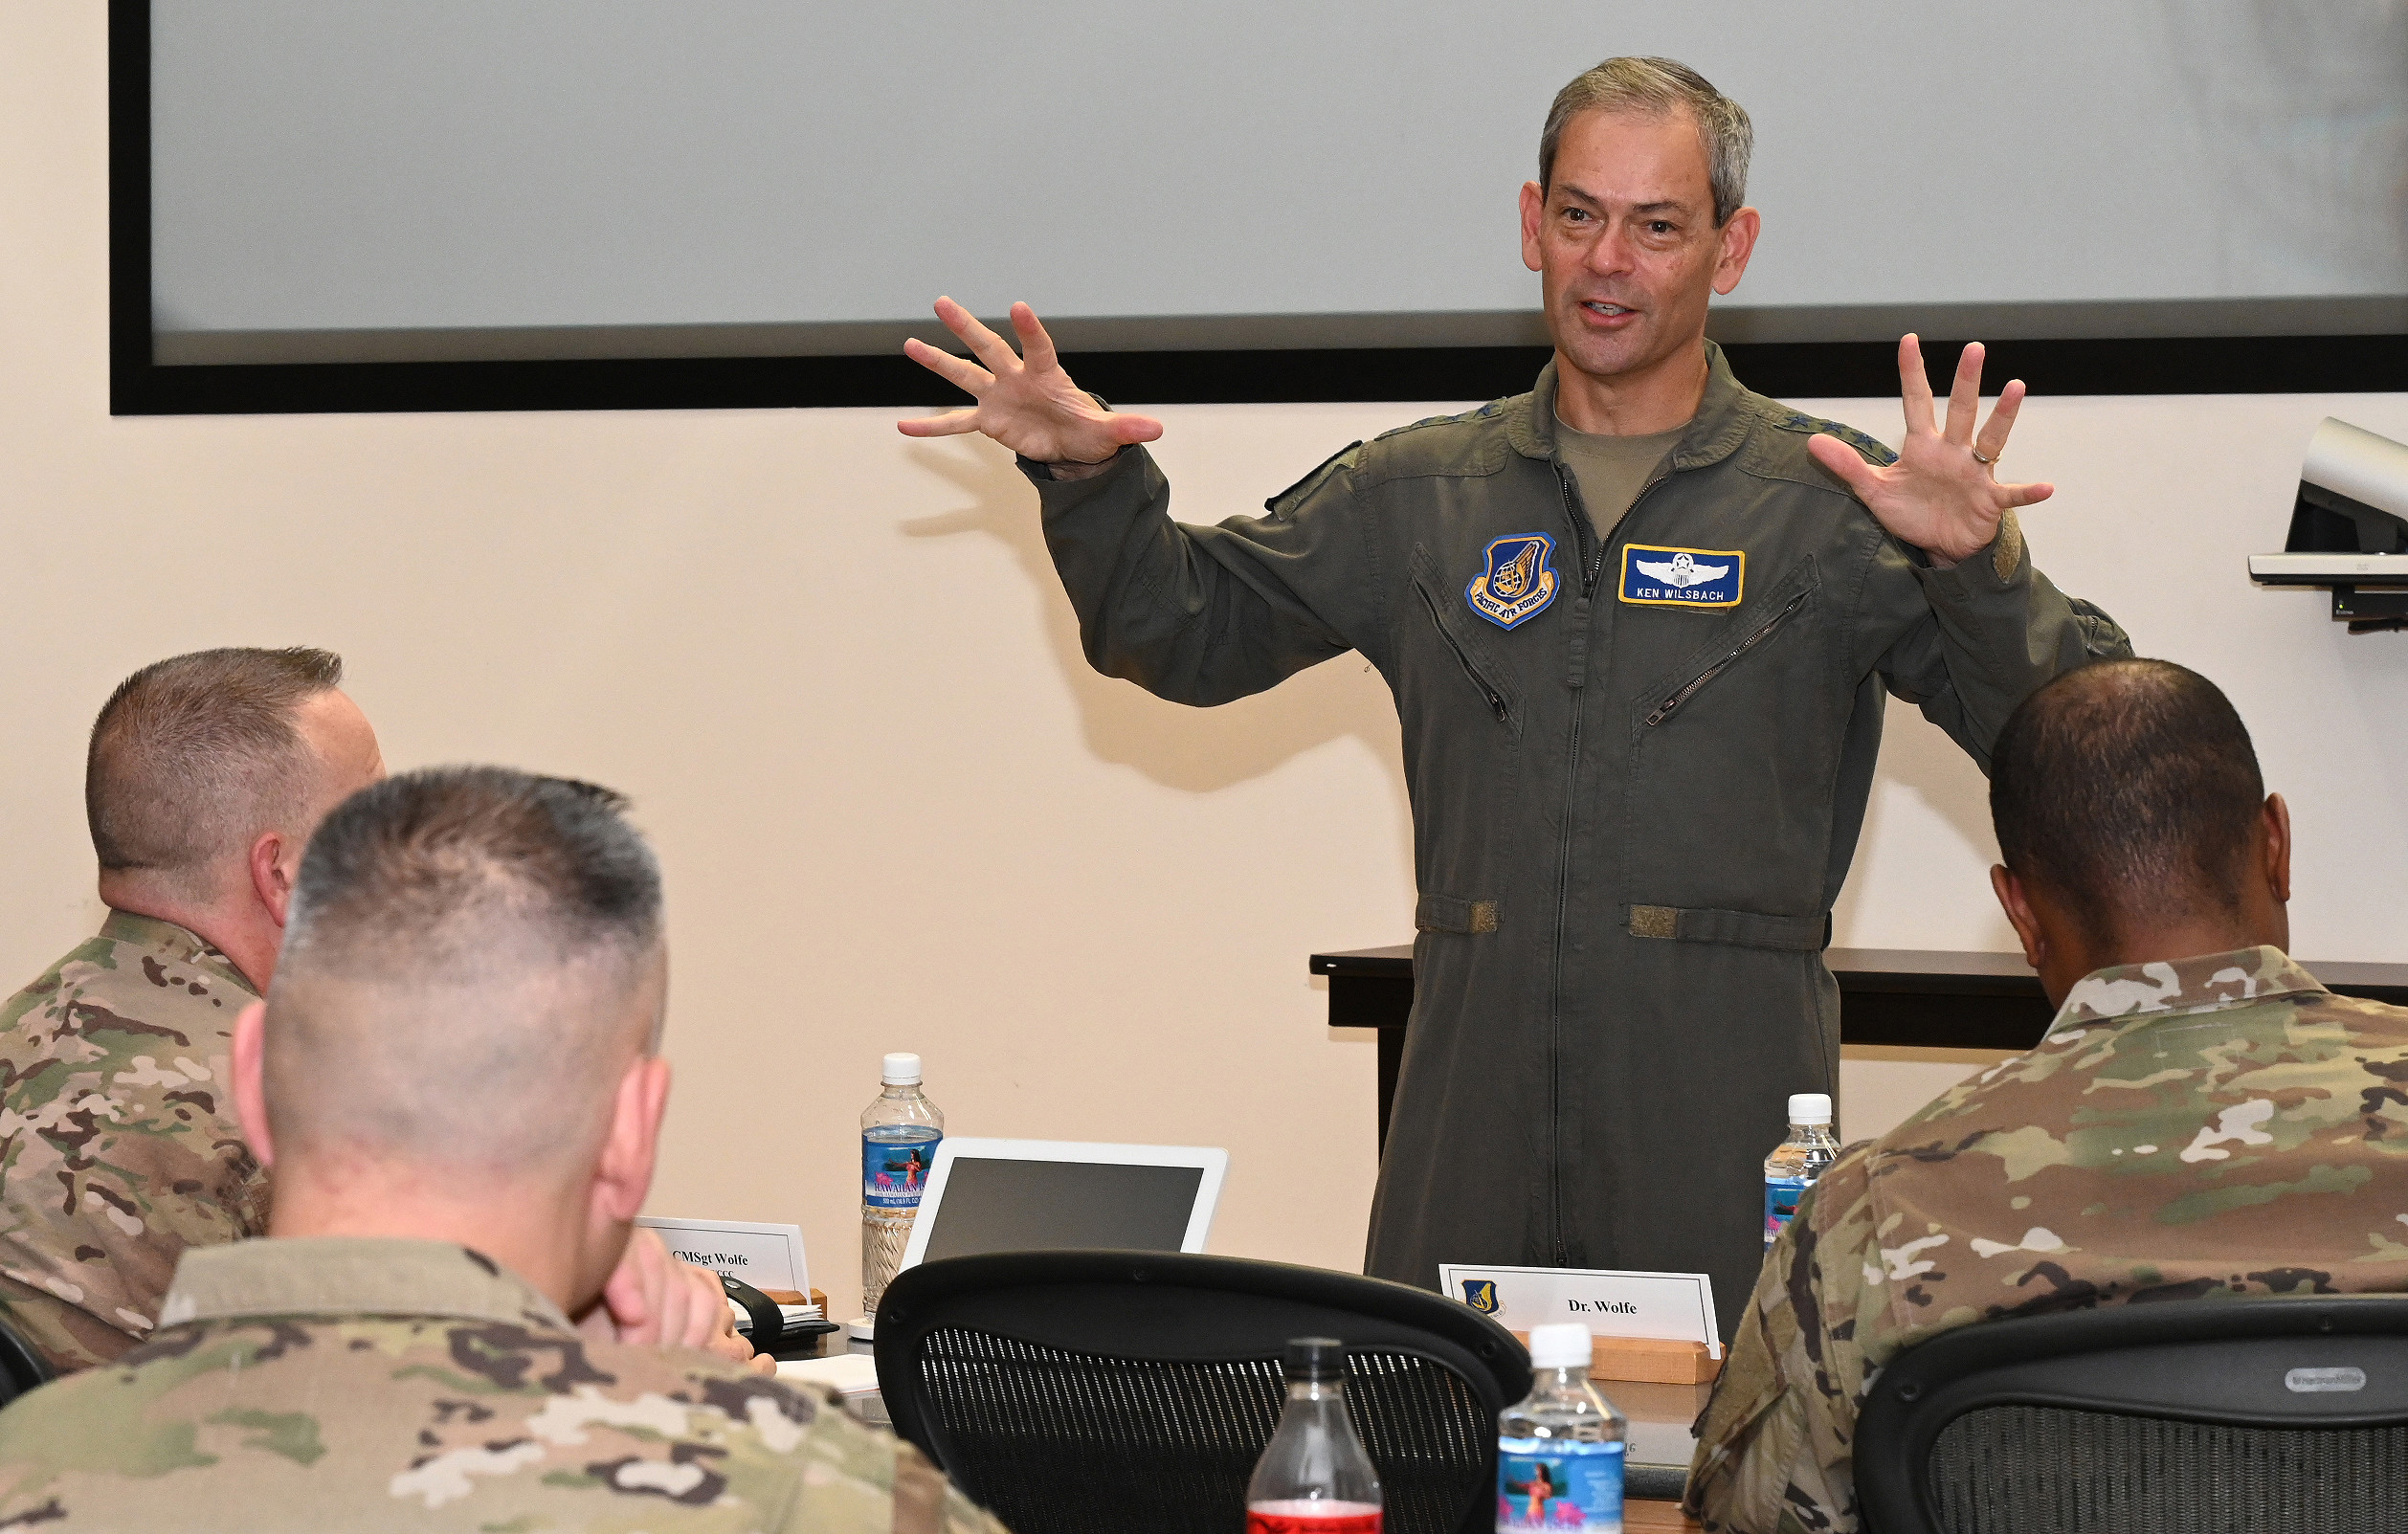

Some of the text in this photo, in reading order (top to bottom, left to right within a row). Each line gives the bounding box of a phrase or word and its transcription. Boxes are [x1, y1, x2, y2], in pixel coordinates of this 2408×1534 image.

[1637, 588, 1724, 600] KEN WILSBACH
[1475, 588, 1548, 619] PACIFIC AIR FORCES
[875, 1182, 918, 1192] HAWAIIAN
[672, 1250, 748, 1266] CMSgt Wolfe
[1568, 1299, 1638, 1315] Dr. Wolfe
